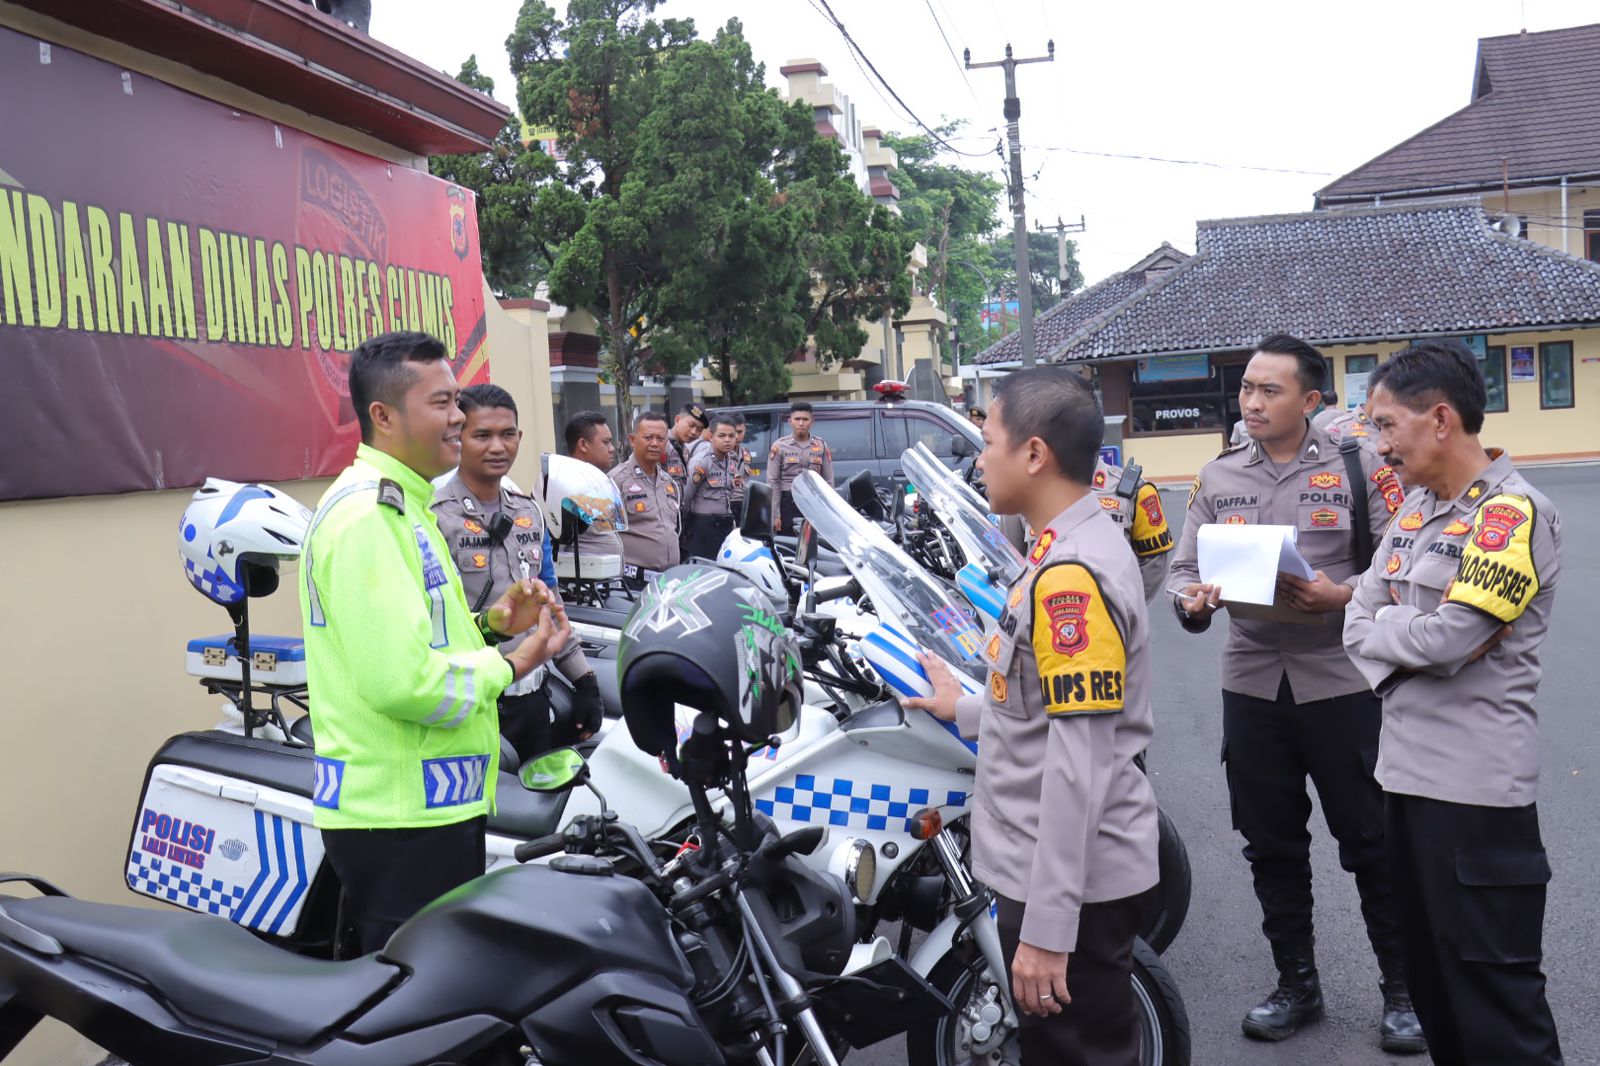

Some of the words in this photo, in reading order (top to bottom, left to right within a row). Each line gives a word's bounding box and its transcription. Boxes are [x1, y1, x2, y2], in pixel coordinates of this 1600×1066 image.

[199, 228, 293, 347] DINAS
[296, 247, 385, 352] POLRES
[386, 265, 456, 361] CIAMIS
[1155, 407, 1200, 420] PROVOS
[1216, 495, 1258, 509] DAFFA.N
[1299, 492, 1349, 505] POLRI
[516, 531, 541, 545] POLRI
[1053, 672, 1086, 704] OPS
[1090, 670, 1123, 701] RES
[140, 807, 216, 855] POLISI
[140, 835, 169, 858] LALU
[167, 844, 206, 870] LINTAS
